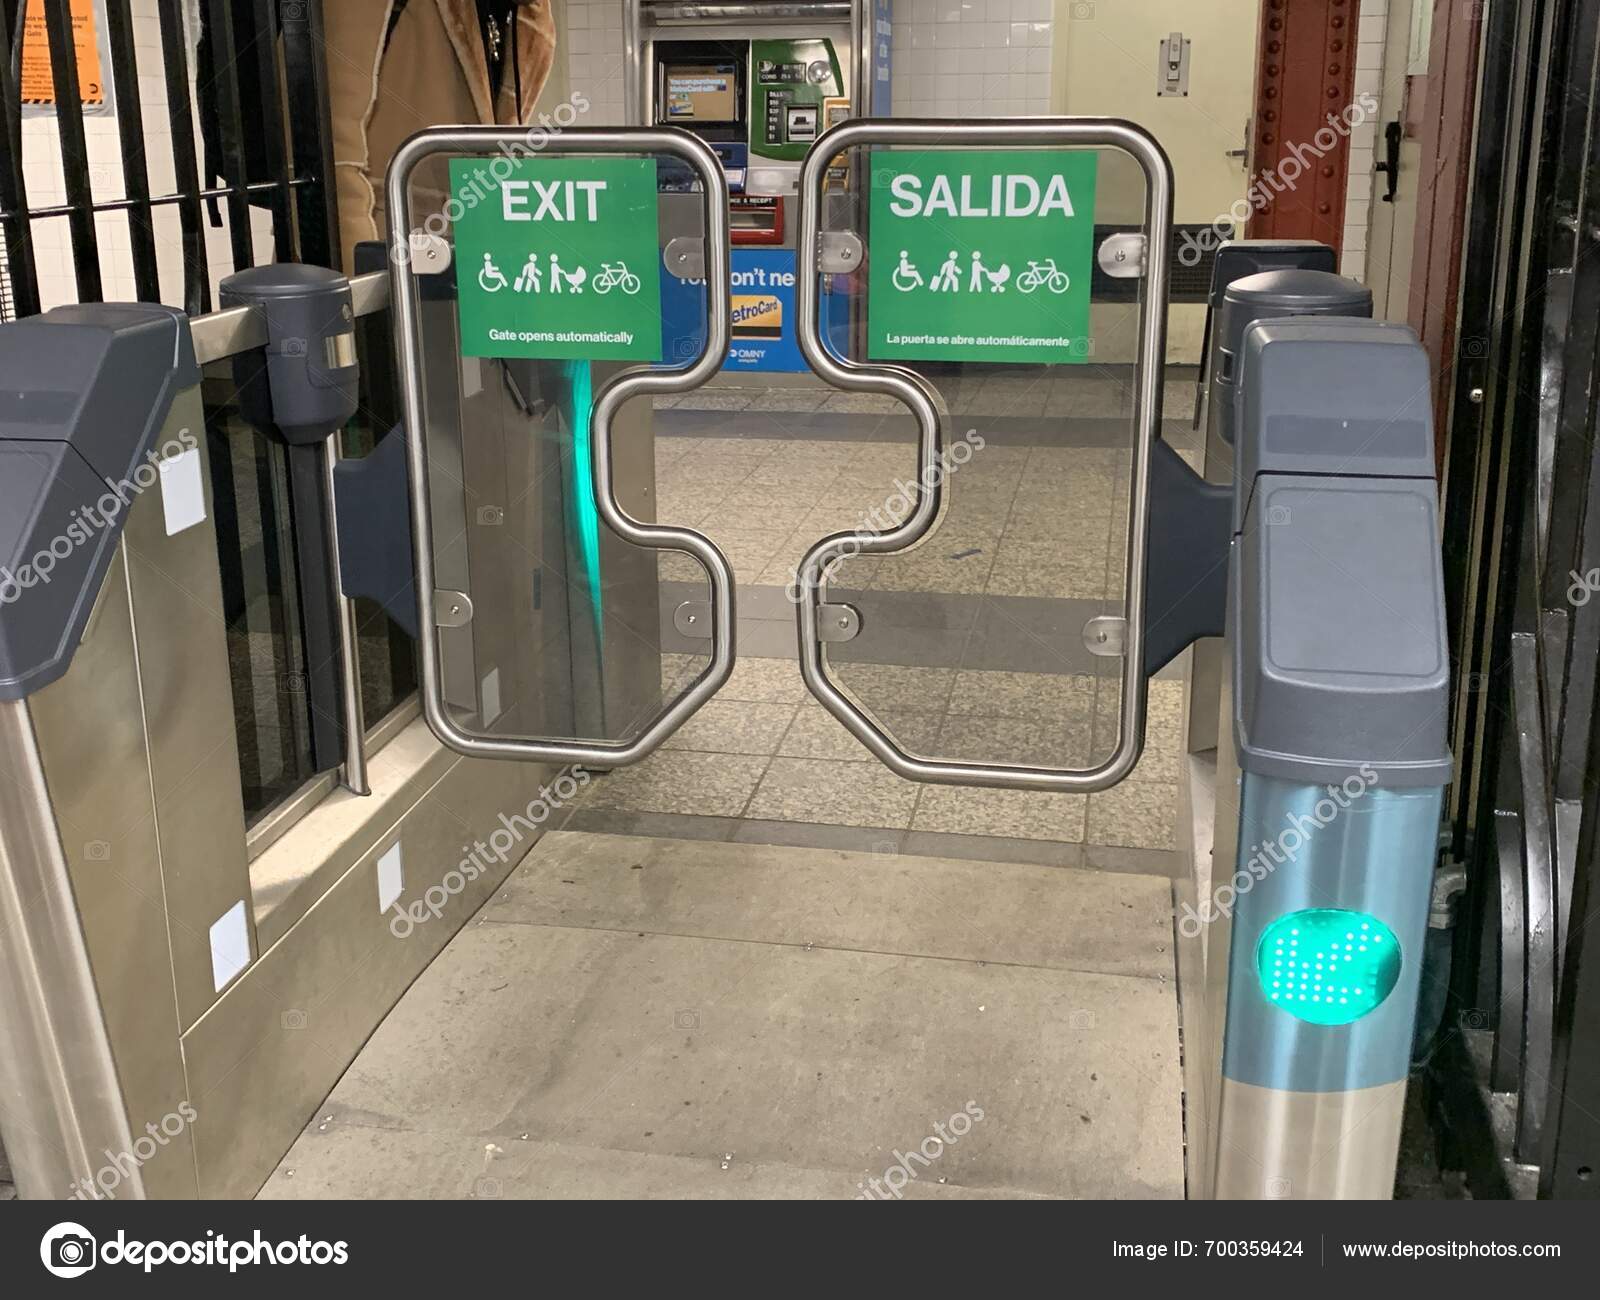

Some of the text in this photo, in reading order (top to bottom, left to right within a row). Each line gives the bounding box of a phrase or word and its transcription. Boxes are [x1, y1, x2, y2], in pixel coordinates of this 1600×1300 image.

[501, 180, 607, 222] EXIT
[889, 173, 1075, 218] SALIDA
[731, 268, 766, 286] on't
[732, 300, 778, 324] etroCard
[489, 328, 634, 345] Gate opens automatically
[886, 333, 1070, 347] La puerta se abre automáticamente
[738, 349, 766, 358] OMNY
